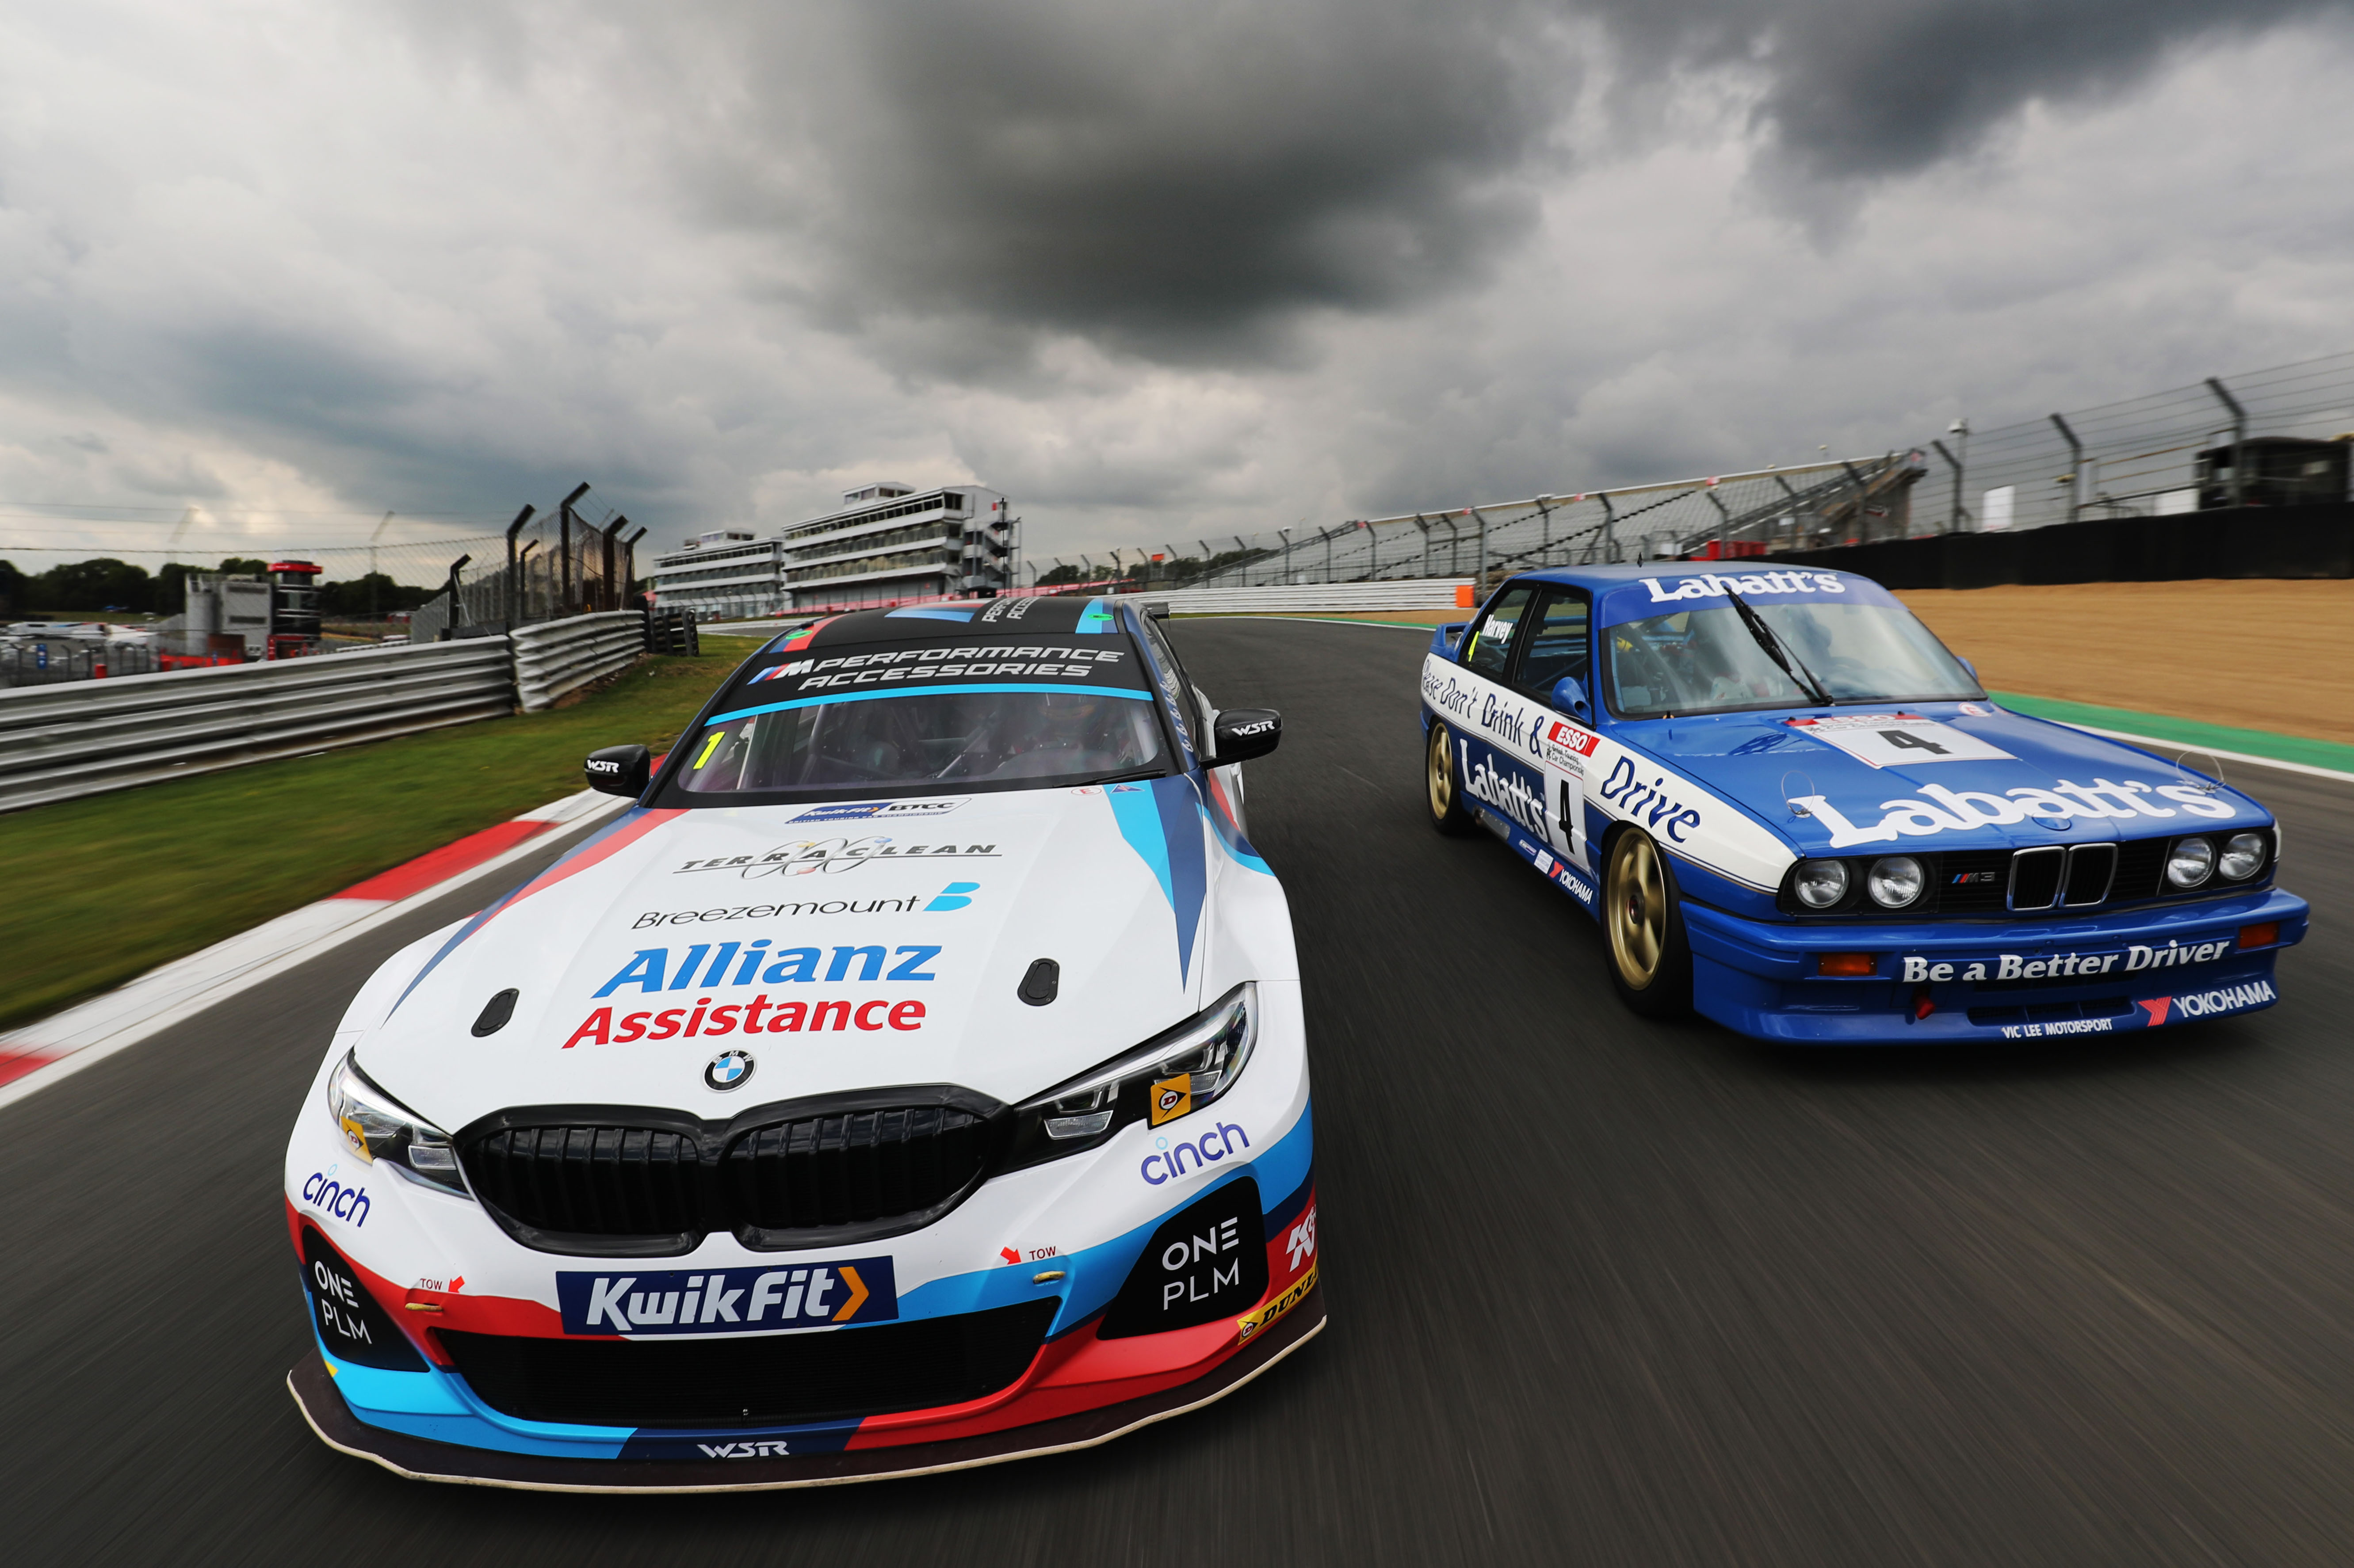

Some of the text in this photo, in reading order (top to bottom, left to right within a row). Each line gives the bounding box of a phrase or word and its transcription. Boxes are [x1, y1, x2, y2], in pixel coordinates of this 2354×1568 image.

[1639, 570, 1846, 603] Labatt's
[1482, 614, 1513, 644] Harvey
[814, 647, 1125, 672] PERFORMANCE
[798, 664, 1093, 691] ACCESSORIES
[1231, 720, 1275, 736] WSR
[1556, 725, 1588, 751] ESSO
[1877, 730, 1953, 755] 4
[587, 759, 619, 773] WSR
[693, 731, 725, 769] 1
[1440, 677, 1479, 719] Don't
[1481, 693, 1525, 747] Drink
[1529, 716, 1544, 758] &
[1600, 755, 1700, 843] Drive
[888, 802, 955, 811] BTCC
[1460, 738, 1548, 843] Labatt's
[1559, 779, 1575, 855] 4
[1787, 778, 2237, 849] Labatt's
[1559, 869, 1593, 904] YOKOHAMA
[631, 895, 921, 930] Breezemount
[591, 939, 943, 999] Allianz
[1903, 939, 2230, 983] Be a Better Driver
[2172, 980, 2276, 1018] YOKOHAMA
[561, 994, 926, 1049] Assistance
[2002, 1019, 2113, 1039] VIC LEE MOTORSPORT
[713, 1050, 754, 1064] BMW
[1141, 1122, 1250, 1185] cinch
[303, 1164, 371, 1228] cinch
[1029, 1246, 1057, 1261] TOW
[1162, 1216, 1239, 1270] ONE
[315, 1260, 359, 1308] ONE
[420, 1278, 443, 1290] TOW
[1163, 1257, 1239, 1310] PLM
[322, 1299, 372, 1344] PLM
[697, 1440, 790, 1458] WSR
